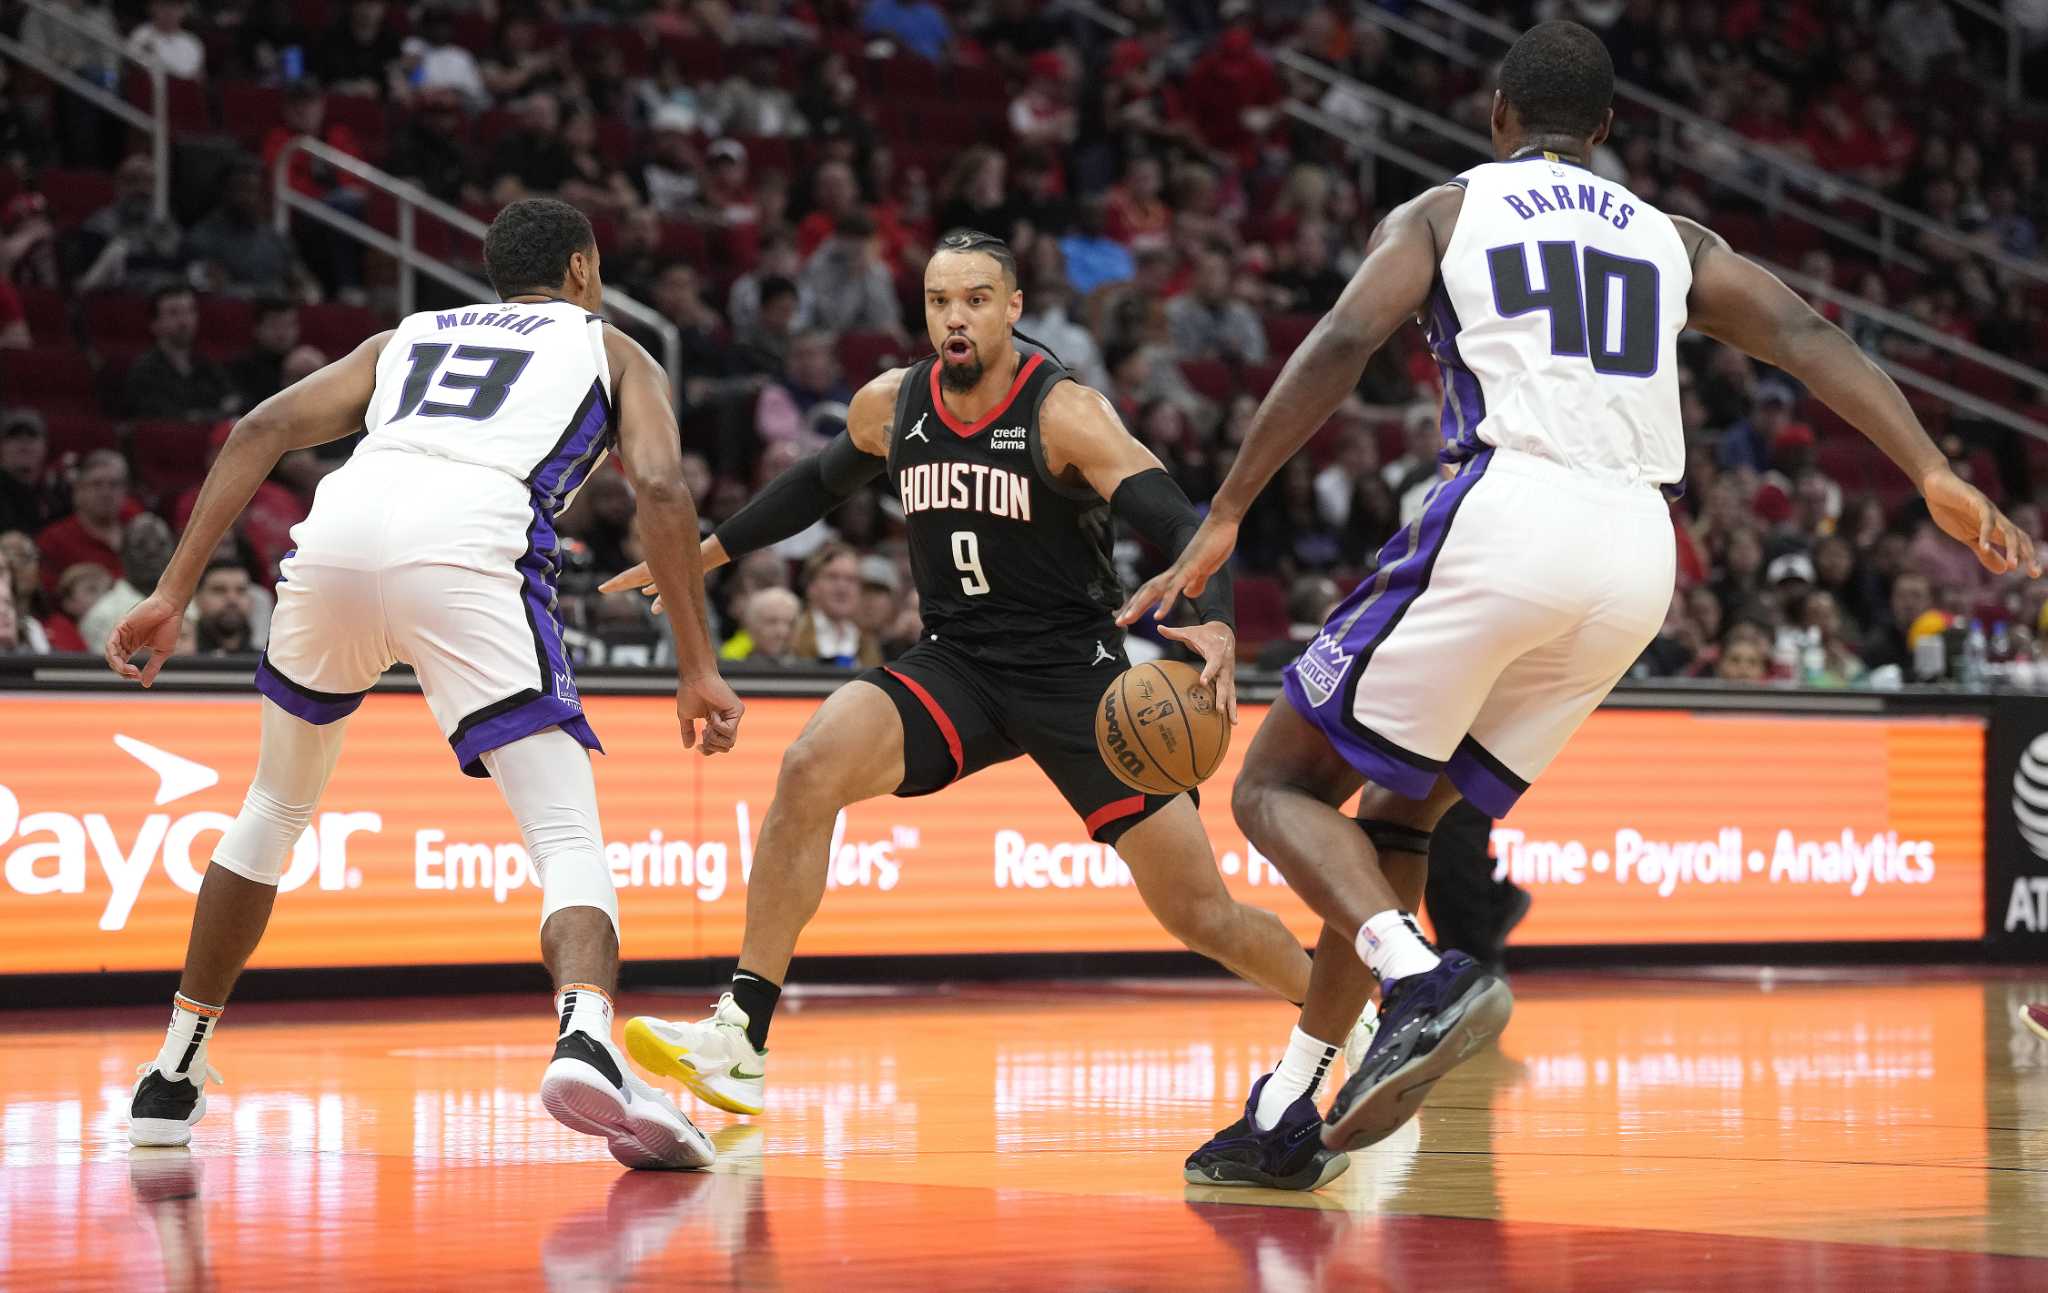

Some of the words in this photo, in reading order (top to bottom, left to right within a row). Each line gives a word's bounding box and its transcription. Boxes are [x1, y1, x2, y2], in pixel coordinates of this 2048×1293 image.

[1503, 184, 1635, 230] BARNES
[436, 312, 556, 336] MURRAY
[1486, 240, 1660, 379] 40
[384, 343, 535, 422] 13
[990, 437, 1026, 450] karma
[993, 426, 1027, 438] credit
[900, 462, 1031, 522] HOUSTON
[951, 531, 990, 596] 9
[415, 828, 728, 904] Empering
[1489, 827, 1588, 884] Time
[1614, 826, 1743, 898] Payroll
[1768, 826, 1936, 897] Analytics
